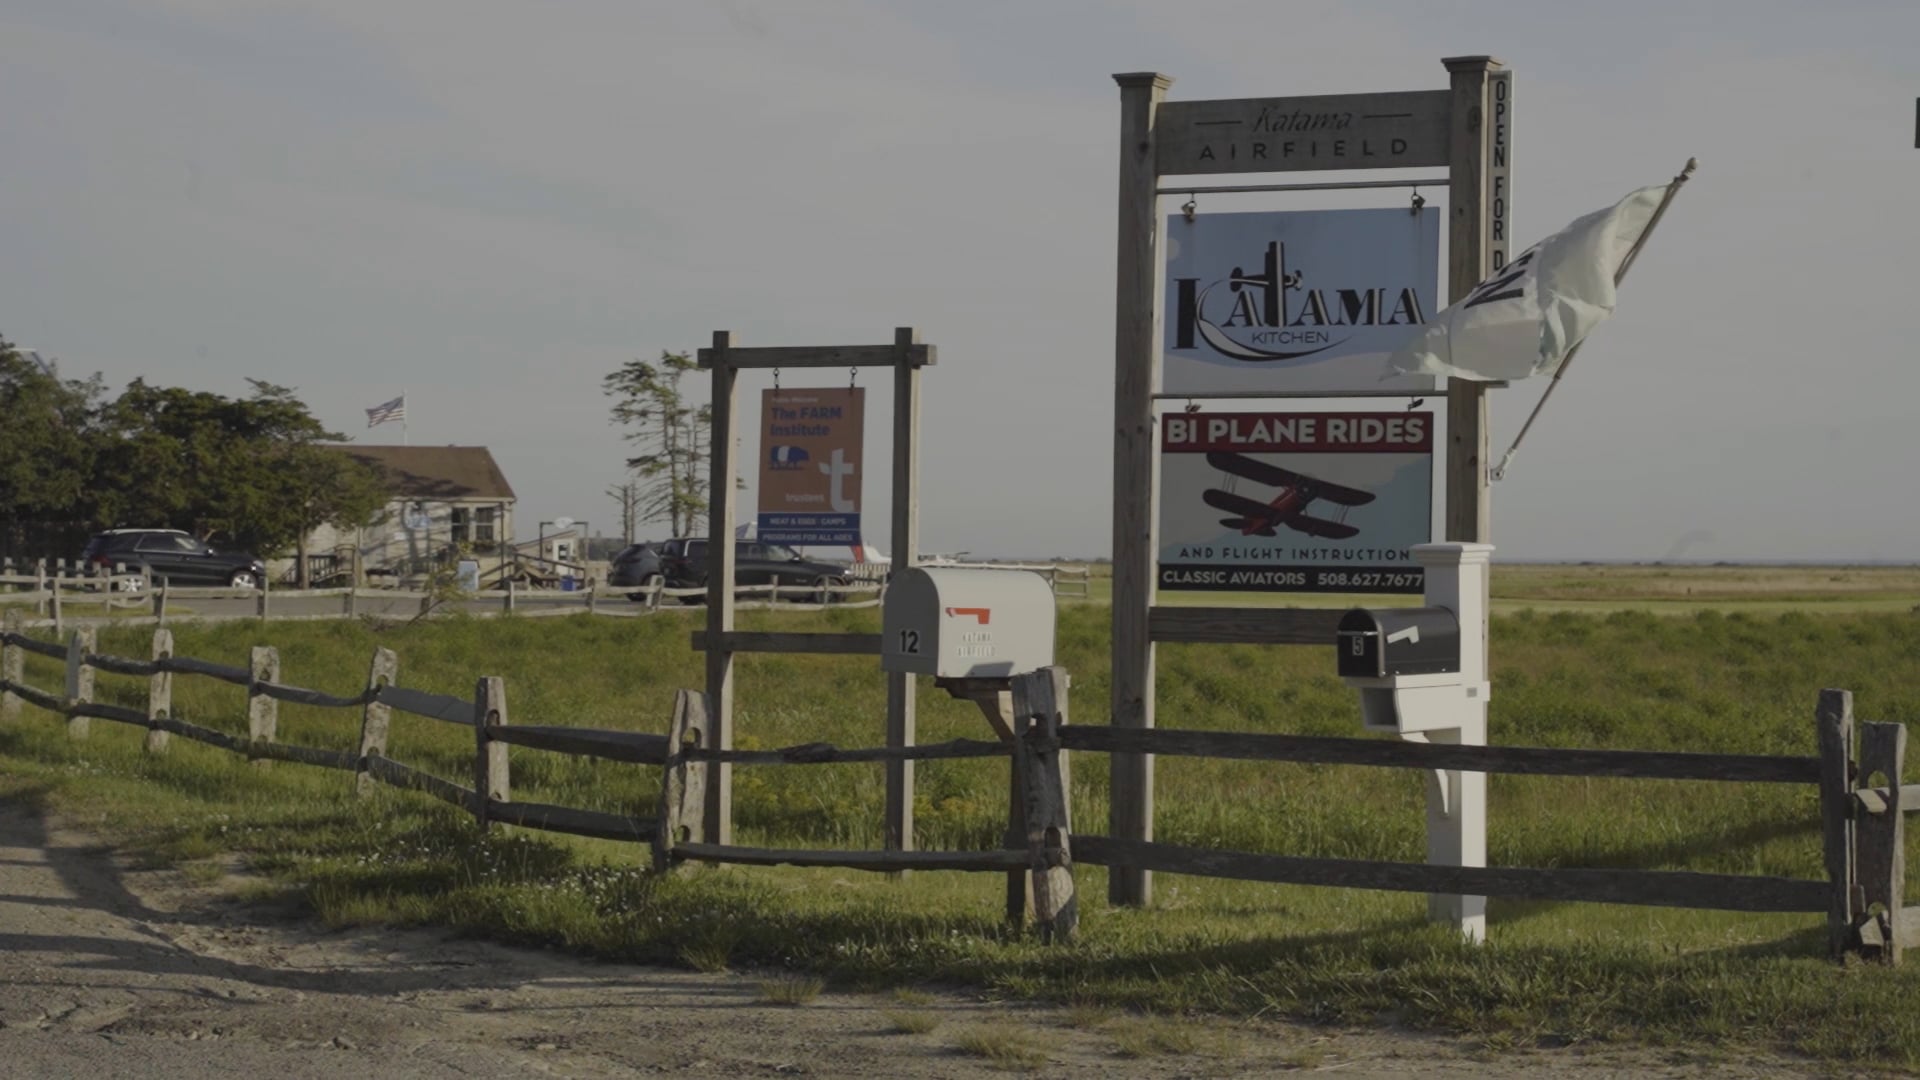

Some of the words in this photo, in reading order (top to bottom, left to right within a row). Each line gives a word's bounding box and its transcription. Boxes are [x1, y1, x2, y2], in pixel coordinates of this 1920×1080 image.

[1252, 107, 1353, 132] Katama
[1493, 80, 1506, 167] OPEN
[1199, 139, 1408, 160] AIRFIELD
[1492, 176, 1505, 241] FOR
[1173, 243, 1426, 350] KATAMA
[1251, 329, 1330, 345] KITCHEN
[771, 406, 797, 420] The
[800, 406, 842, 420] FARM
[769, 423, 830, 437] Institute
[1166, 419, 1196, 443] BI
[1208, 419, 1316, 443] PLANE
[1326, 418, 1425, 444] RIDES
[1179, 547, 1214, 559] AND
[1222, 547, 1284, 560] FLIGHT
[1292, 548, 1411, 561] INSTRUCTION
[1162, 570, 1226, 584] CLASSIC
[1229, 571, 1306, 585] AVIATORS
[1317, 572, 1424, 587] 508.627.7677
[901, 630, 919, 653] 12
